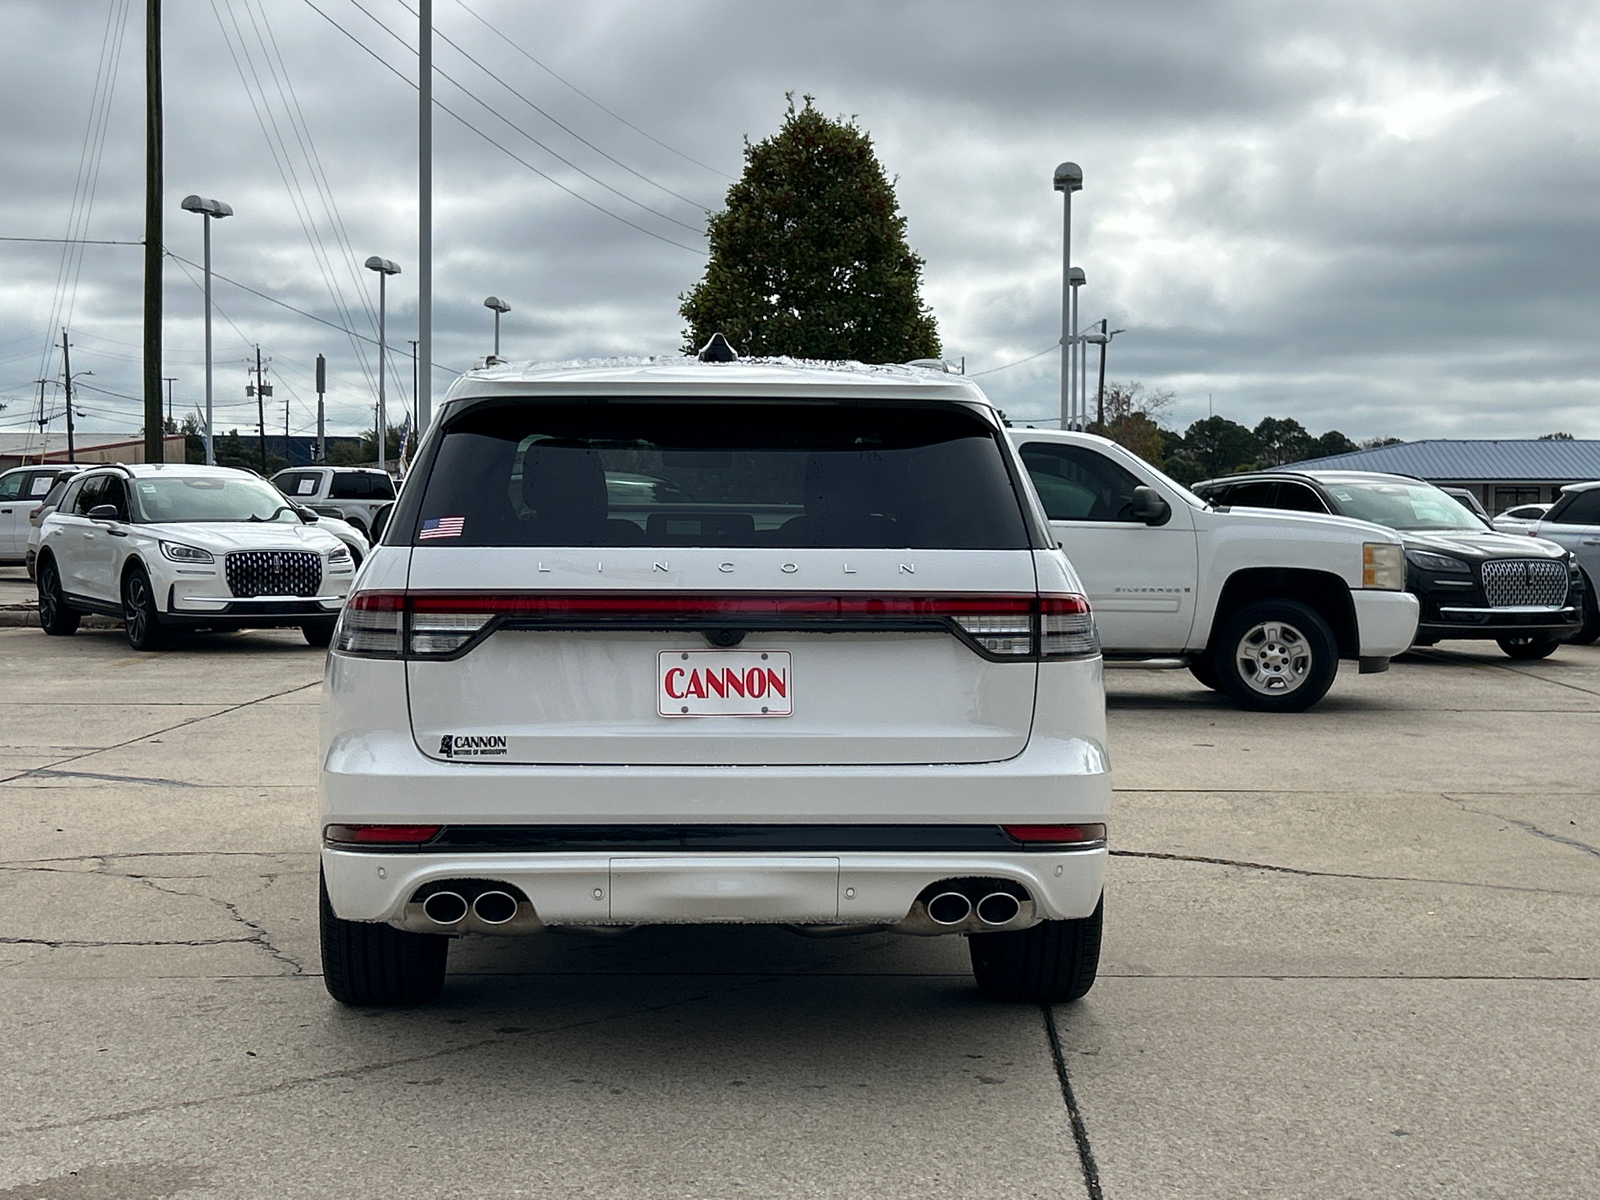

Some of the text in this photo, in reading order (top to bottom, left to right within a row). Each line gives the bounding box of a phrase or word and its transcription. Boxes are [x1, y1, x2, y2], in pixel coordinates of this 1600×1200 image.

[537, 561, 915, 573] LINCOLN
[664, 667, 786, 699] CANNON
[454, 735, 507, 748] CANNON
